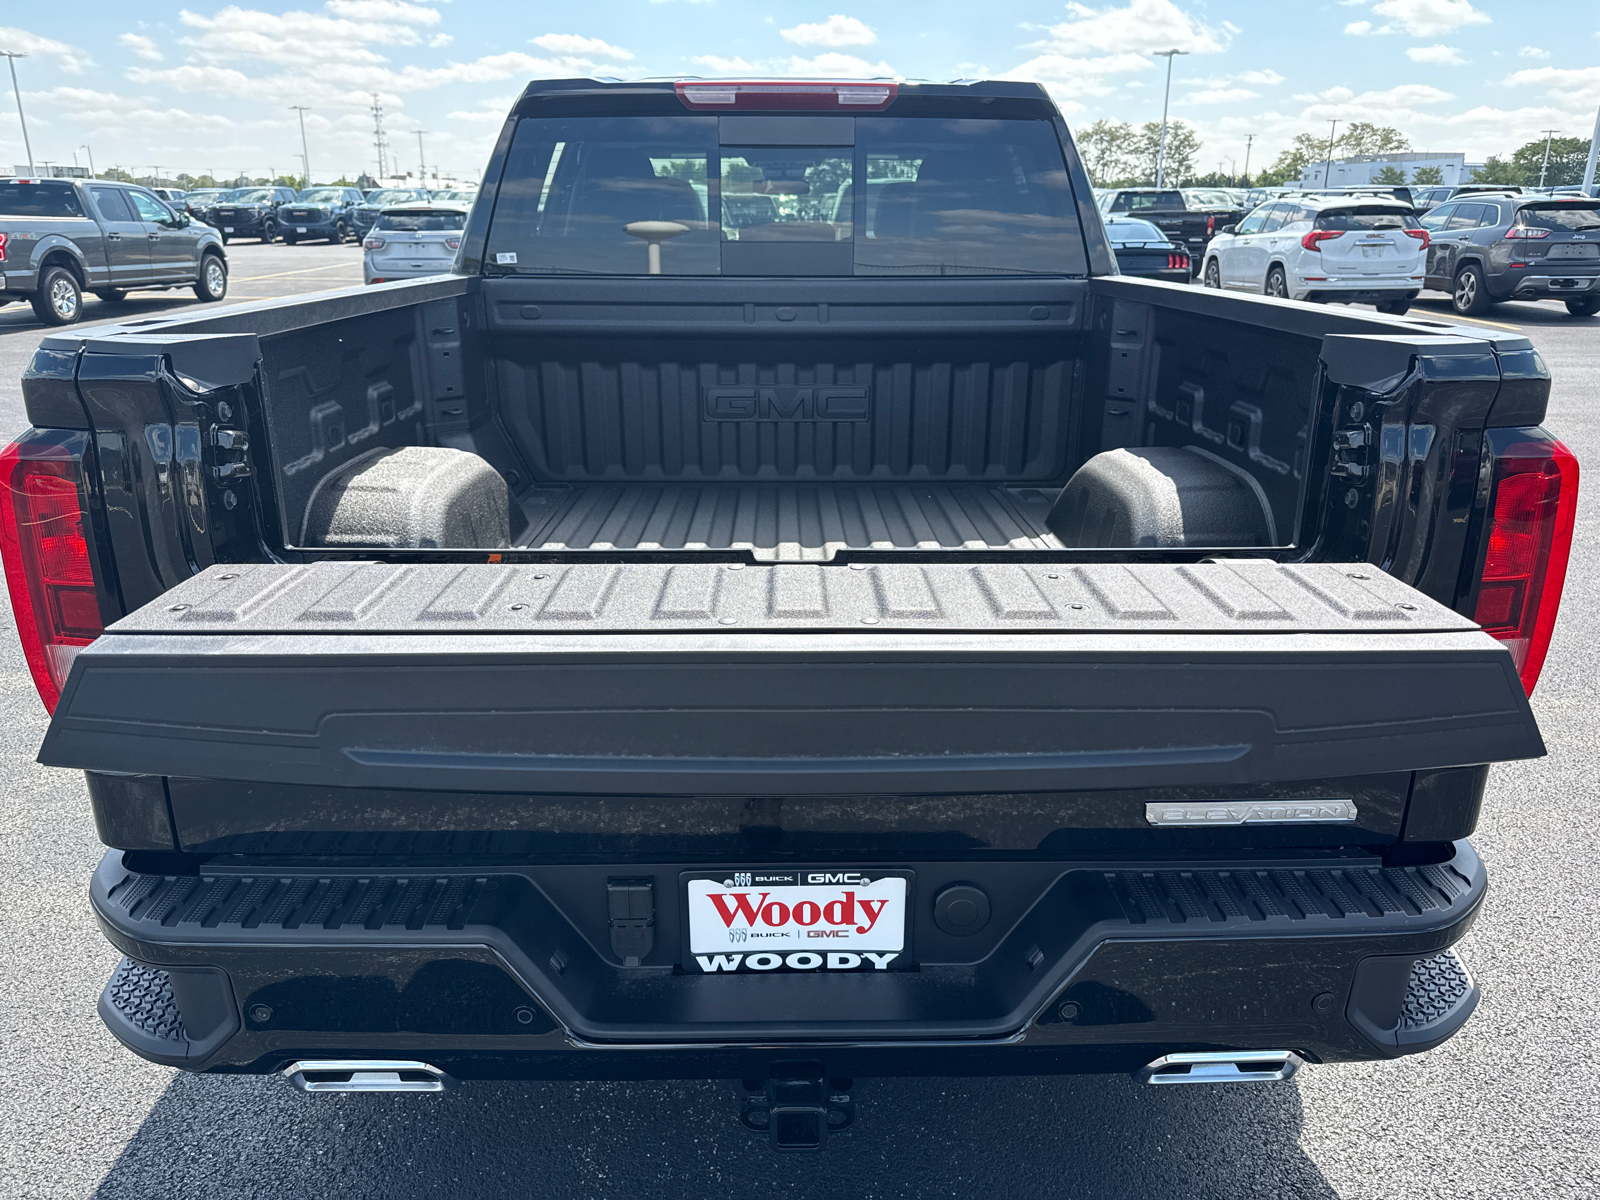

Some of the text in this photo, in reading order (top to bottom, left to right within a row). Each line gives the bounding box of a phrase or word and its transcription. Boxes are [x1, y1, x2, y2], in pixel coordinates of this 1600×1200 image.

[706, 388, 867, 419] GMC
[1162, 805, 1341, 820] ELEVATION
[807, 873, 861, 883] GMC
[706, 891, 890, 935] Woody
[807, 929, 850, 939] GMC
[695, 952, 900, 972] WOODY
